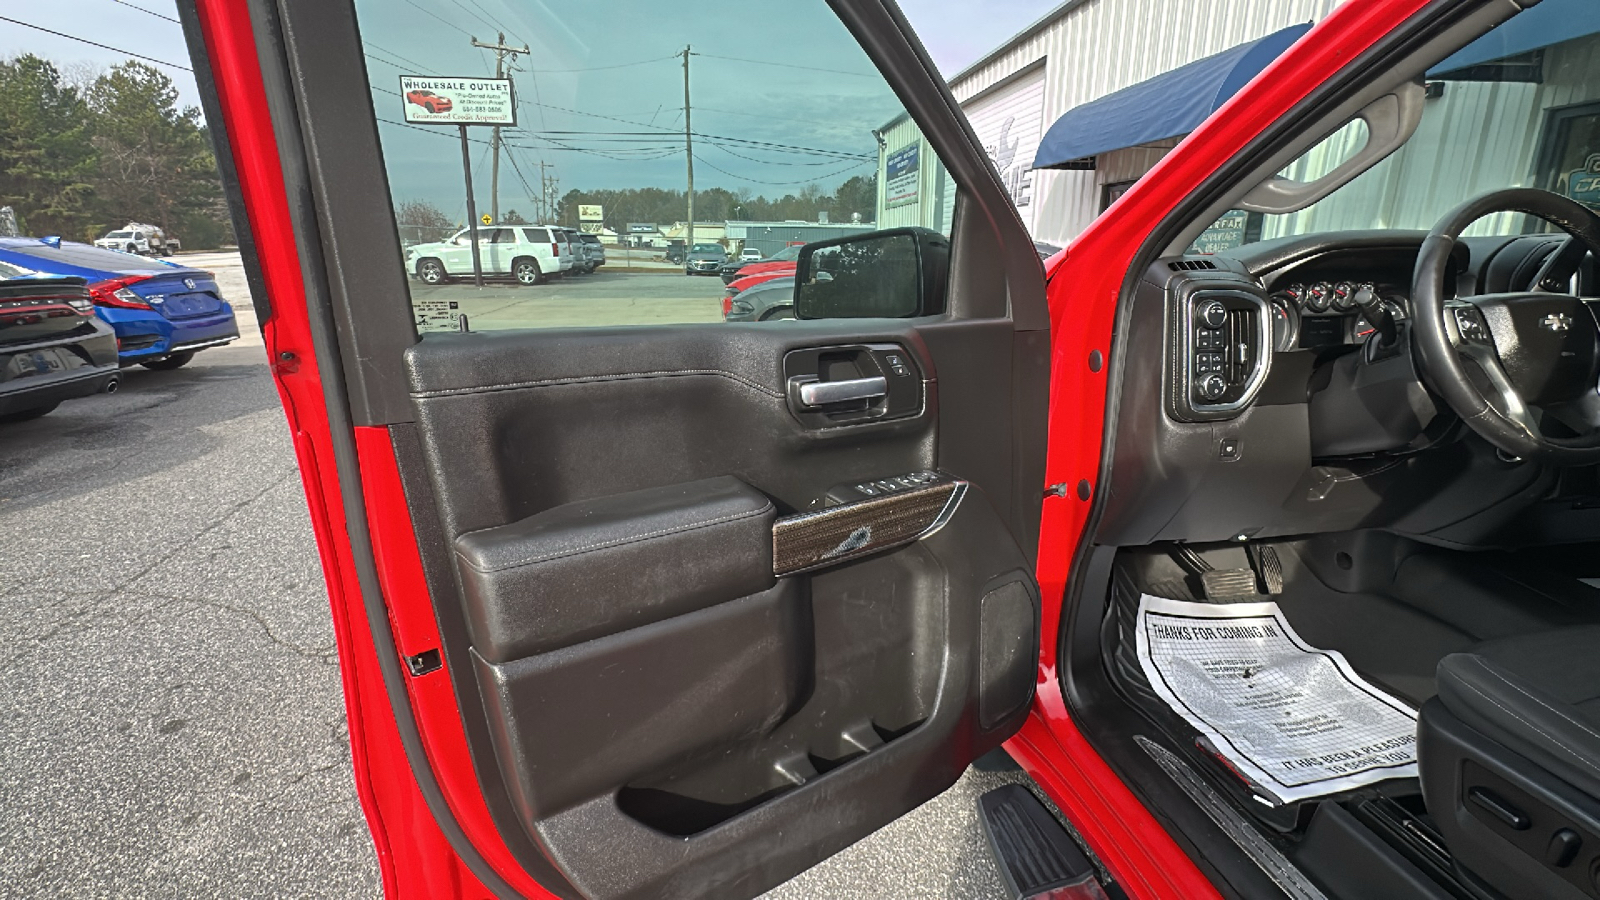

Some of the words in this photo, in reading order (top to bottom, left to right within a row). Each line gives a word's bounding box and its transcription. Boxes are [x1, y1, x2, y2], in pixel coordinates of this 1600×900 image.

[404, 81, 466, 91] WHOLESALE
[470, 83, 508, 91] OUTLET
[412, 112, 451, 120] Guaranteed
[475, 114, 508, 122] Approval!
[1202, 231, 1238, 241] ADVANTAGE
[1205, 243, 1229, 252] DEALER
[1152, 624, 1192, 640] THANKS
[1192, 627, 1217, 640] FOR
[1217, 625, 1263, 639] COMING
[1262, 625, 1278, 638] IN
[1282, 760, 1296, 770] IT
[1296, 757, 1323, 768] HAS
[1322, 751, 1351, 763] BEEN
[1351, 749, 1363, 757] A
[1361, 734, 1416, 754] PLEASURE
[1326, 765, 1347, 773] TO
[1345, 755, 1385, 769] SERVE
[1383, 750, 1410, 763] YOU
